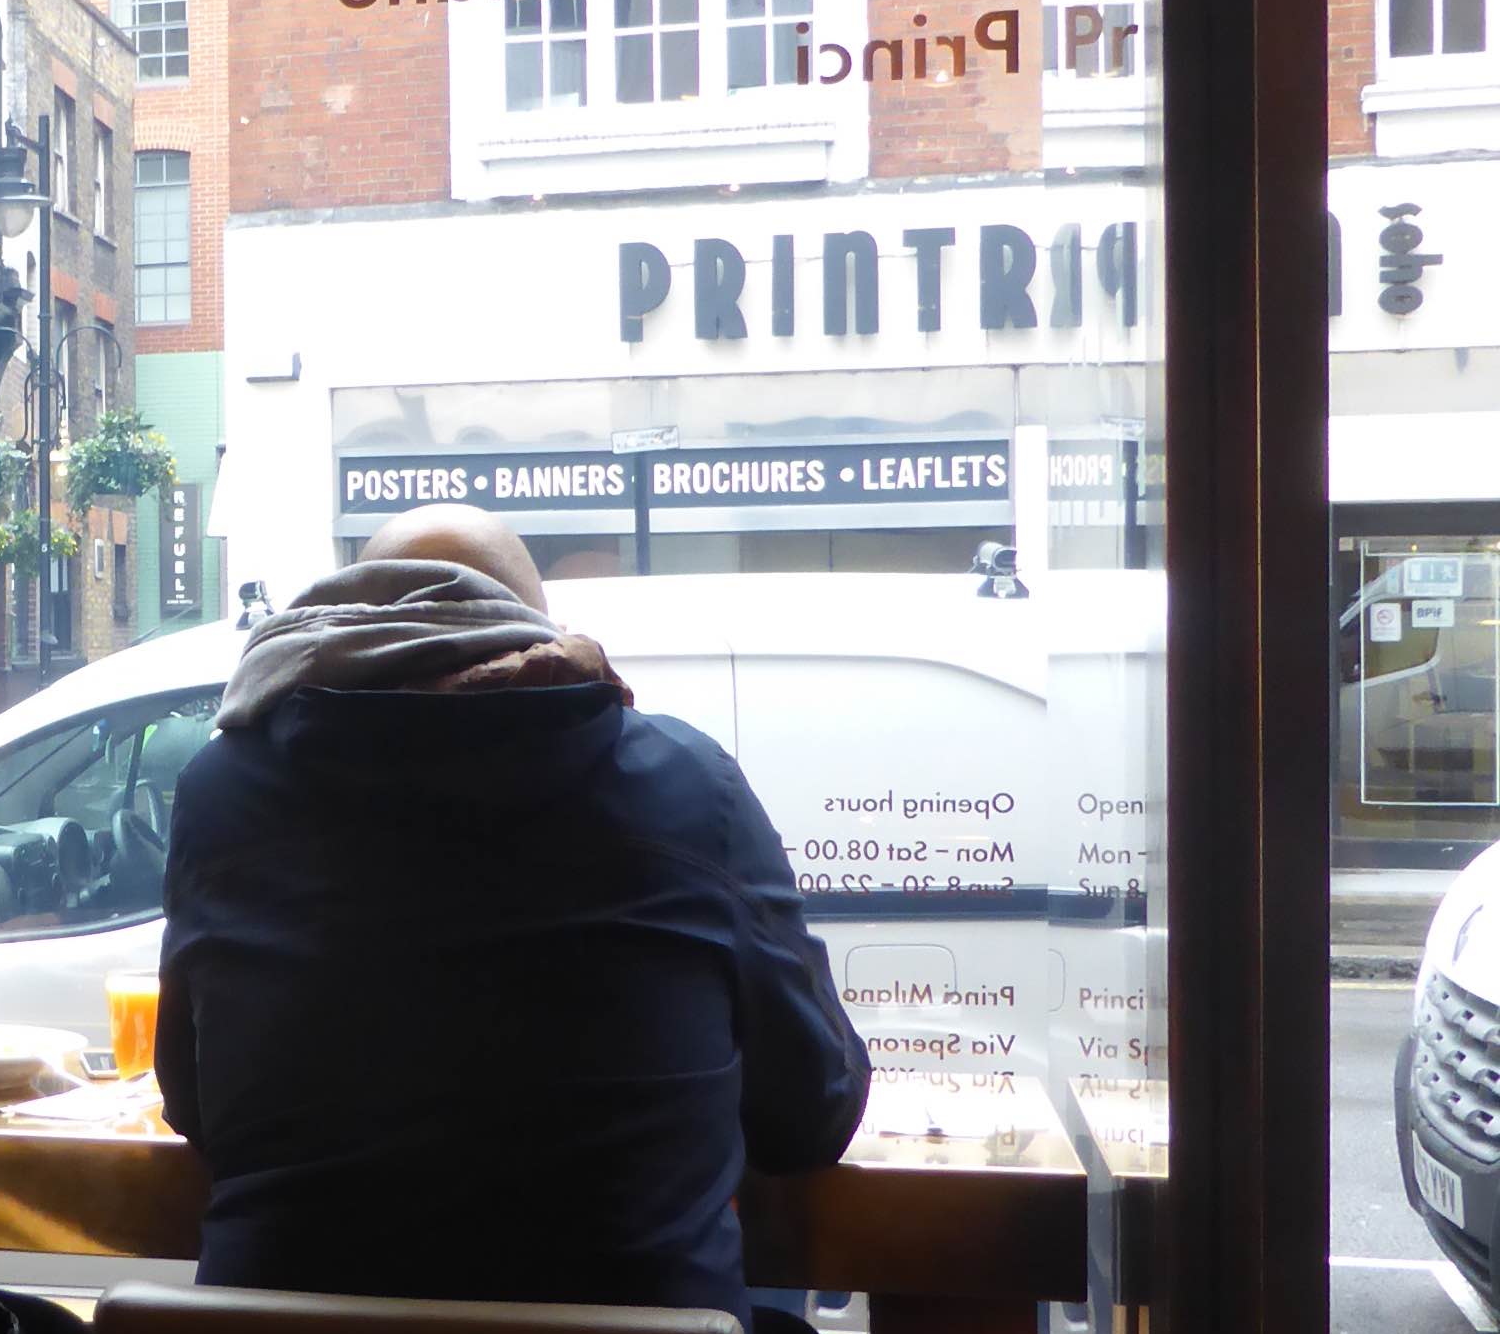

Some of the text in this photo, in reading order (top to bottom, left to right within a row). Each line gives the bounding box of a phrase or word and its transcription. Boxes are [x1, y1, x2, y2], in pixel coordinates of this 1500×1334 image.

[346, 453, 1007, 501] POSTERS BANNERS BROCHURES LEAFLETS
